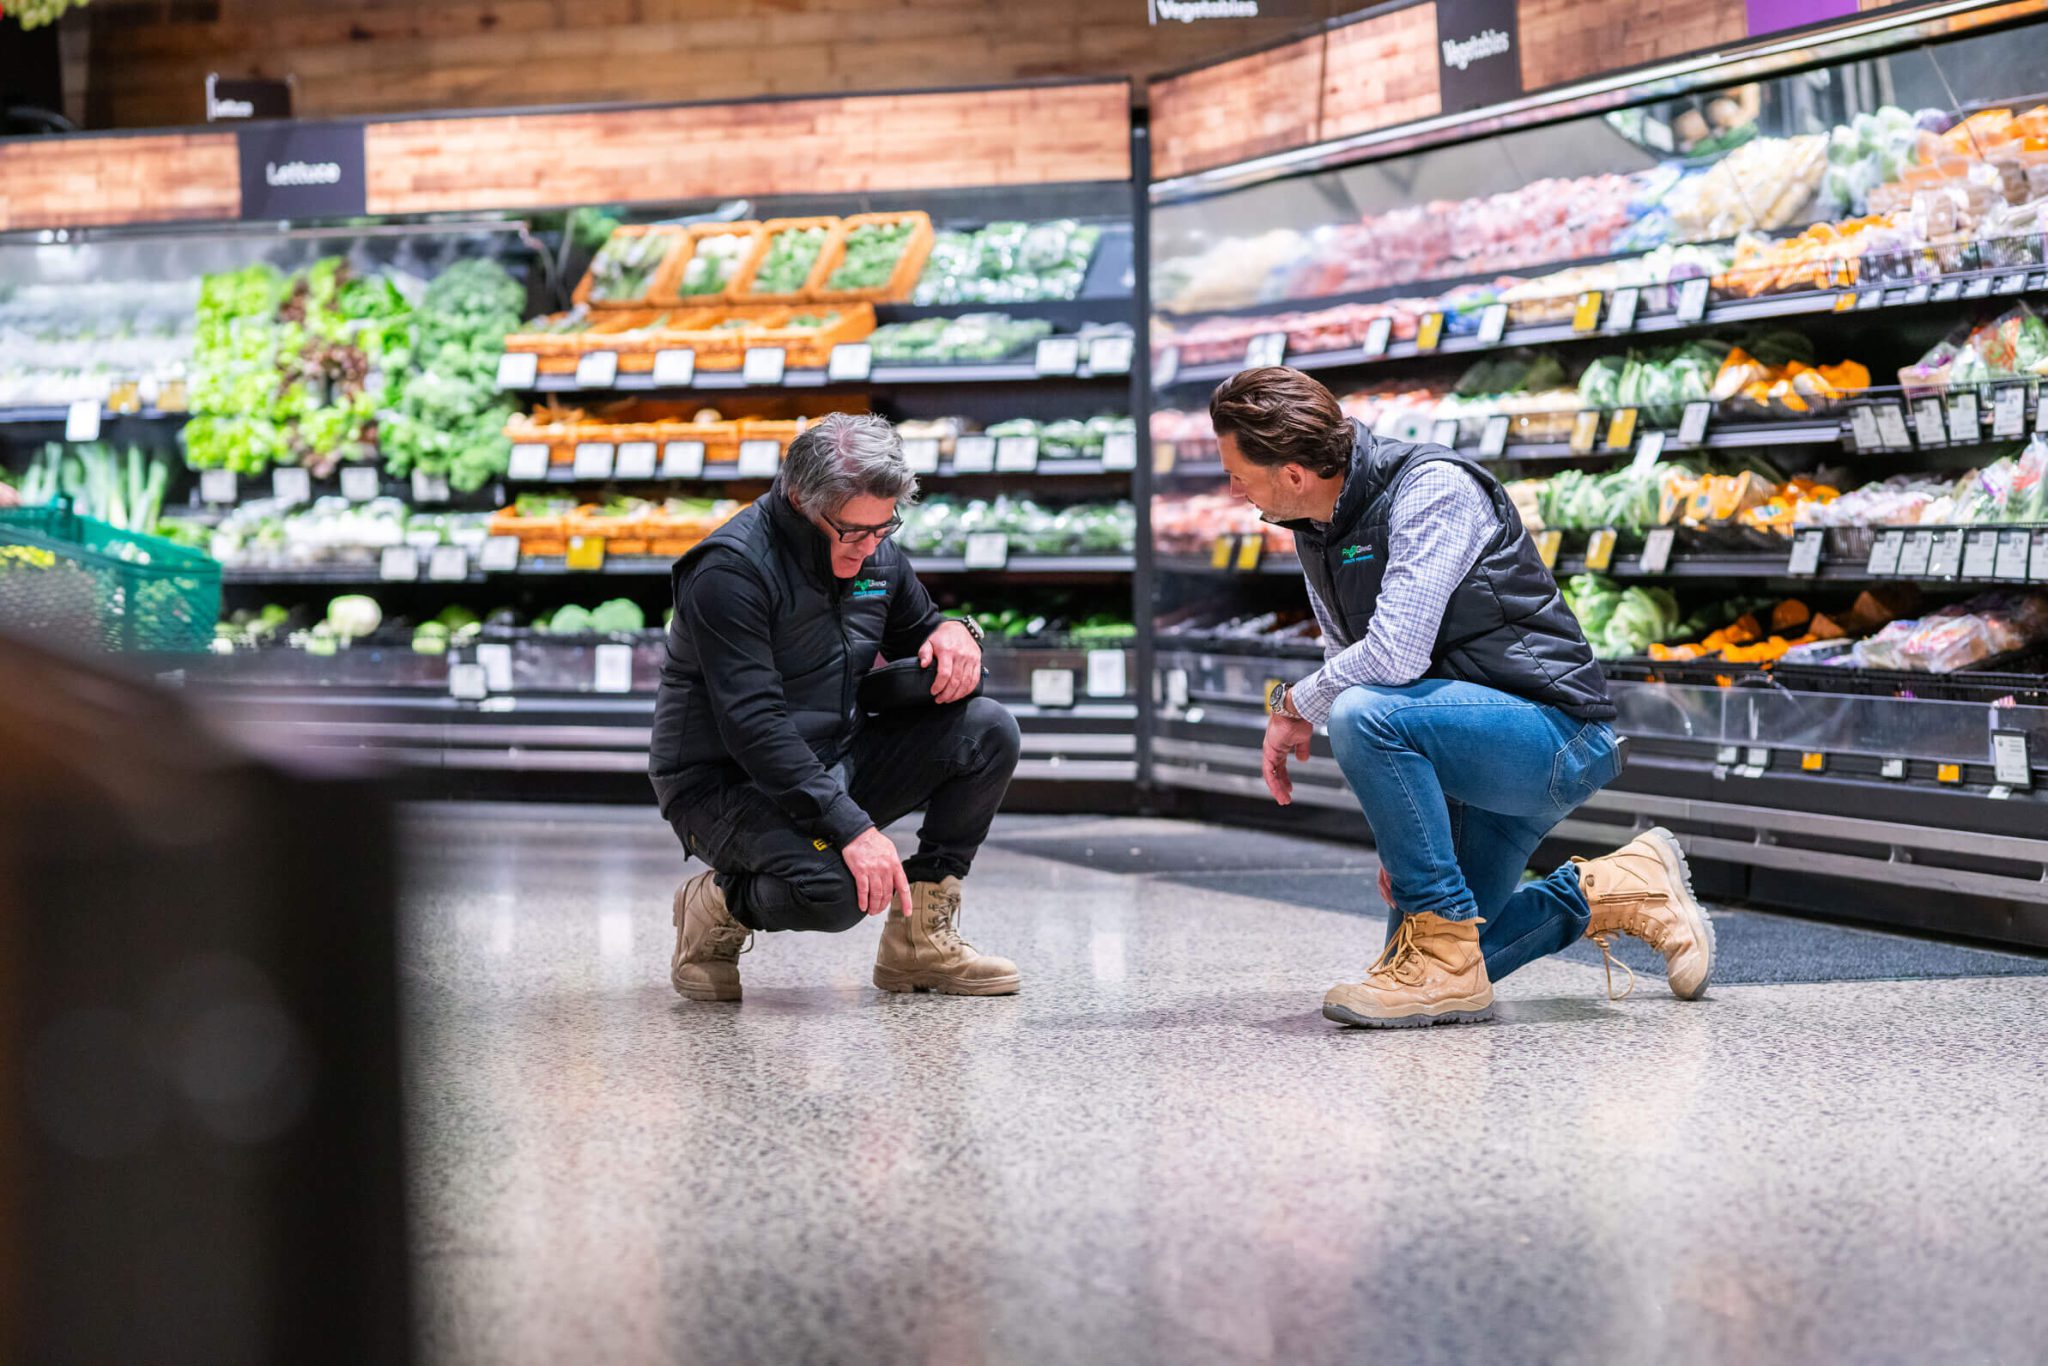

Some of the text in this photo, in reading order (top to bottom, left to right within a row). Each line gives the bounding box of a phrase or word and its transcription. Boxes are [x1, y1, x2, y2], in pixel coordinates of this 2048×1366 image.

[1156, 0, 1258, 23] Vegetables
[1442, 28, 1509, 70] Vegetables
[266, 161, 341, 186] Lettuce
